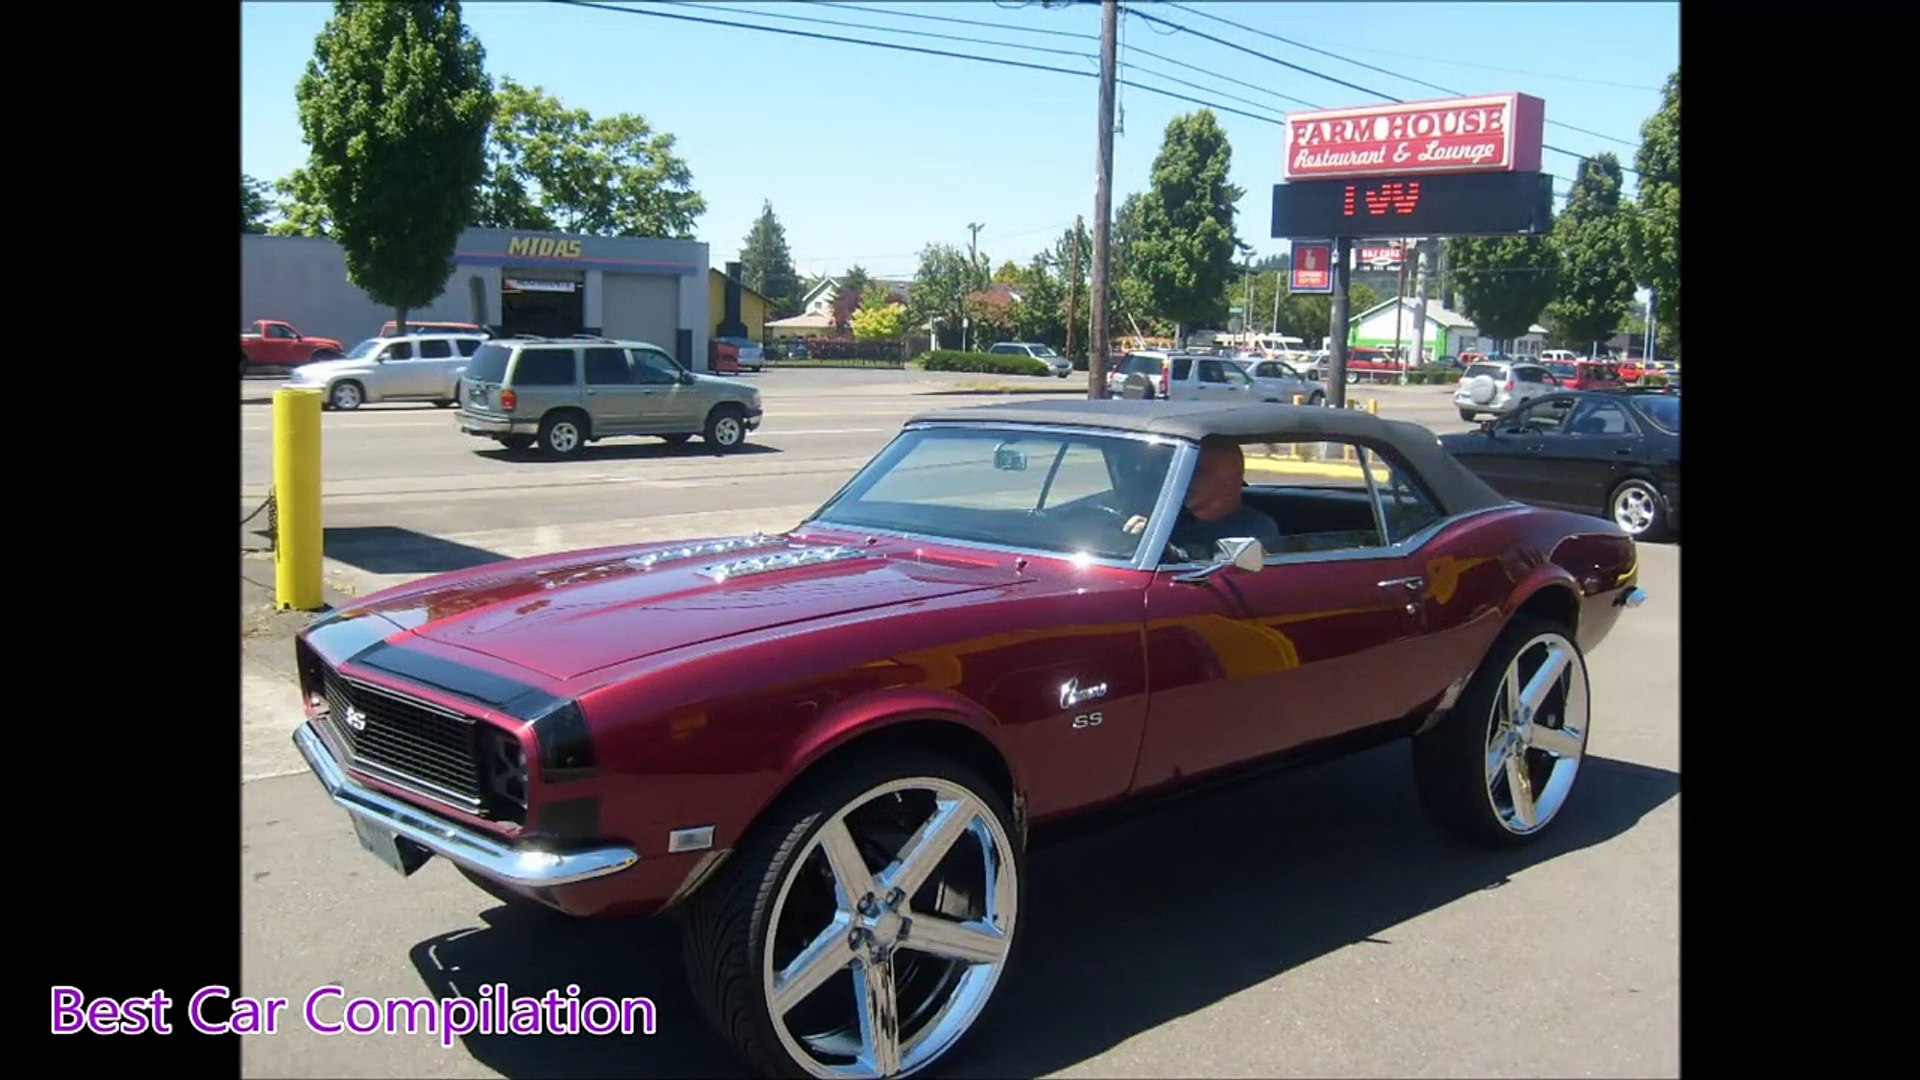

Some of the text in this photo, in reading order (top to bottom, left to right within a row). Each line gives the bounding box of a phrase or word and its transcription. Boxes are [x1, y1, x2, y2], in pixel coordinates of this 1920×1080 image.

[1292, 107, 1504, 146] FARM HOUSE
[1293, 140, 1495, 168] Restaurant & Lounge
[508, 236, 581, 257] MIDAS
[1072, 712, 1103, 728] SS
